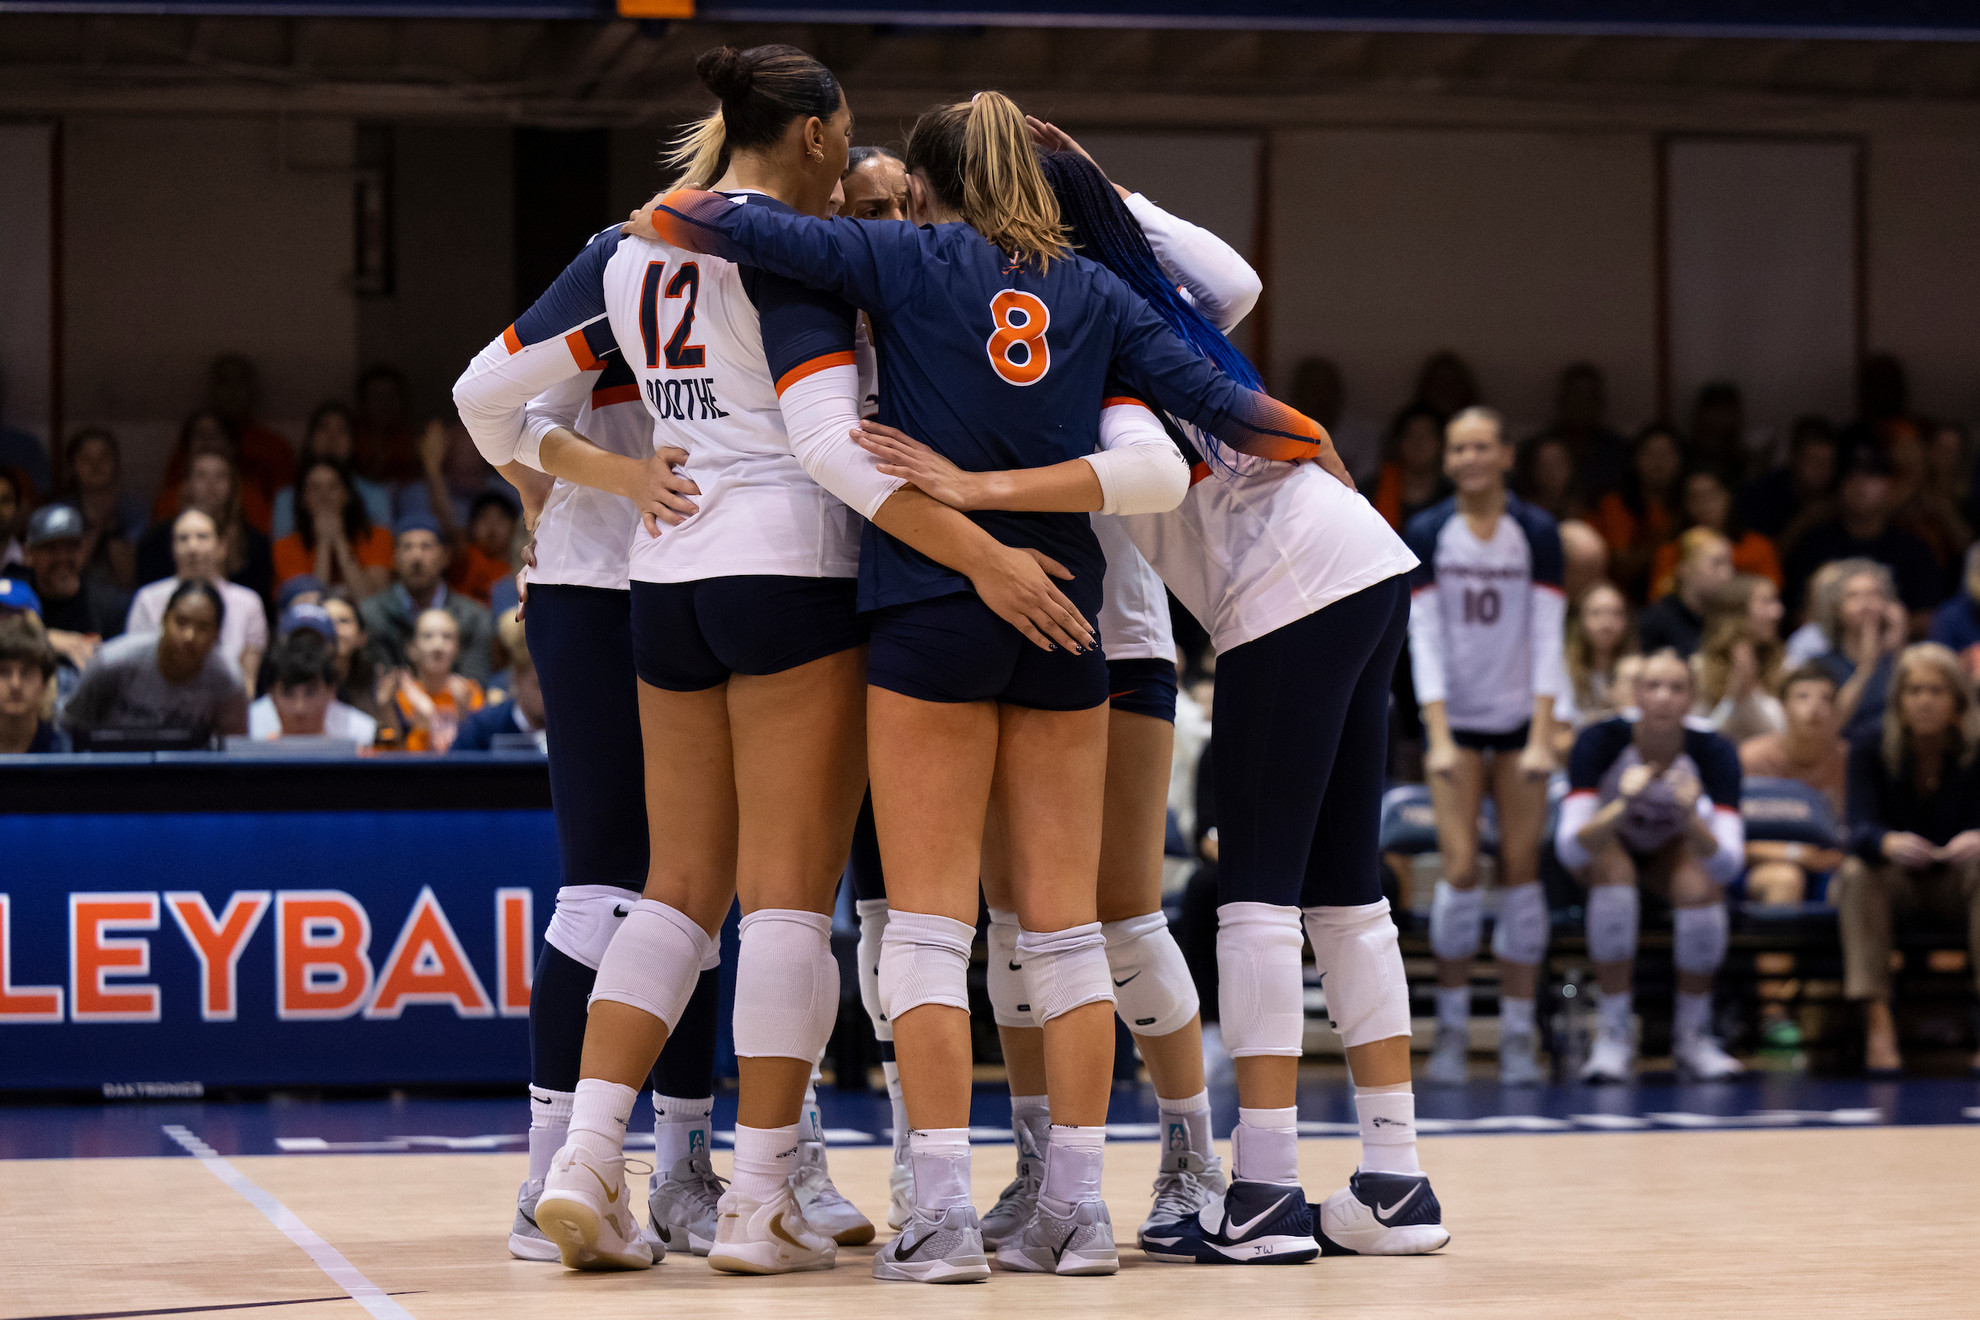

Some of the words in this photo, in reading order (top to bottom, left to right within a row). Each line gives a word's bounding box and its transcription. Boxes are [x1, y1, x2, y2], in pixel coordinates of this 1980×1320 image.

[639, 260, 706, 369] 12
[986, 288, 1051, 387] 8
[1463, 587, 1502, 626] 10
[1253, 1244, 1273, 1255] JW
